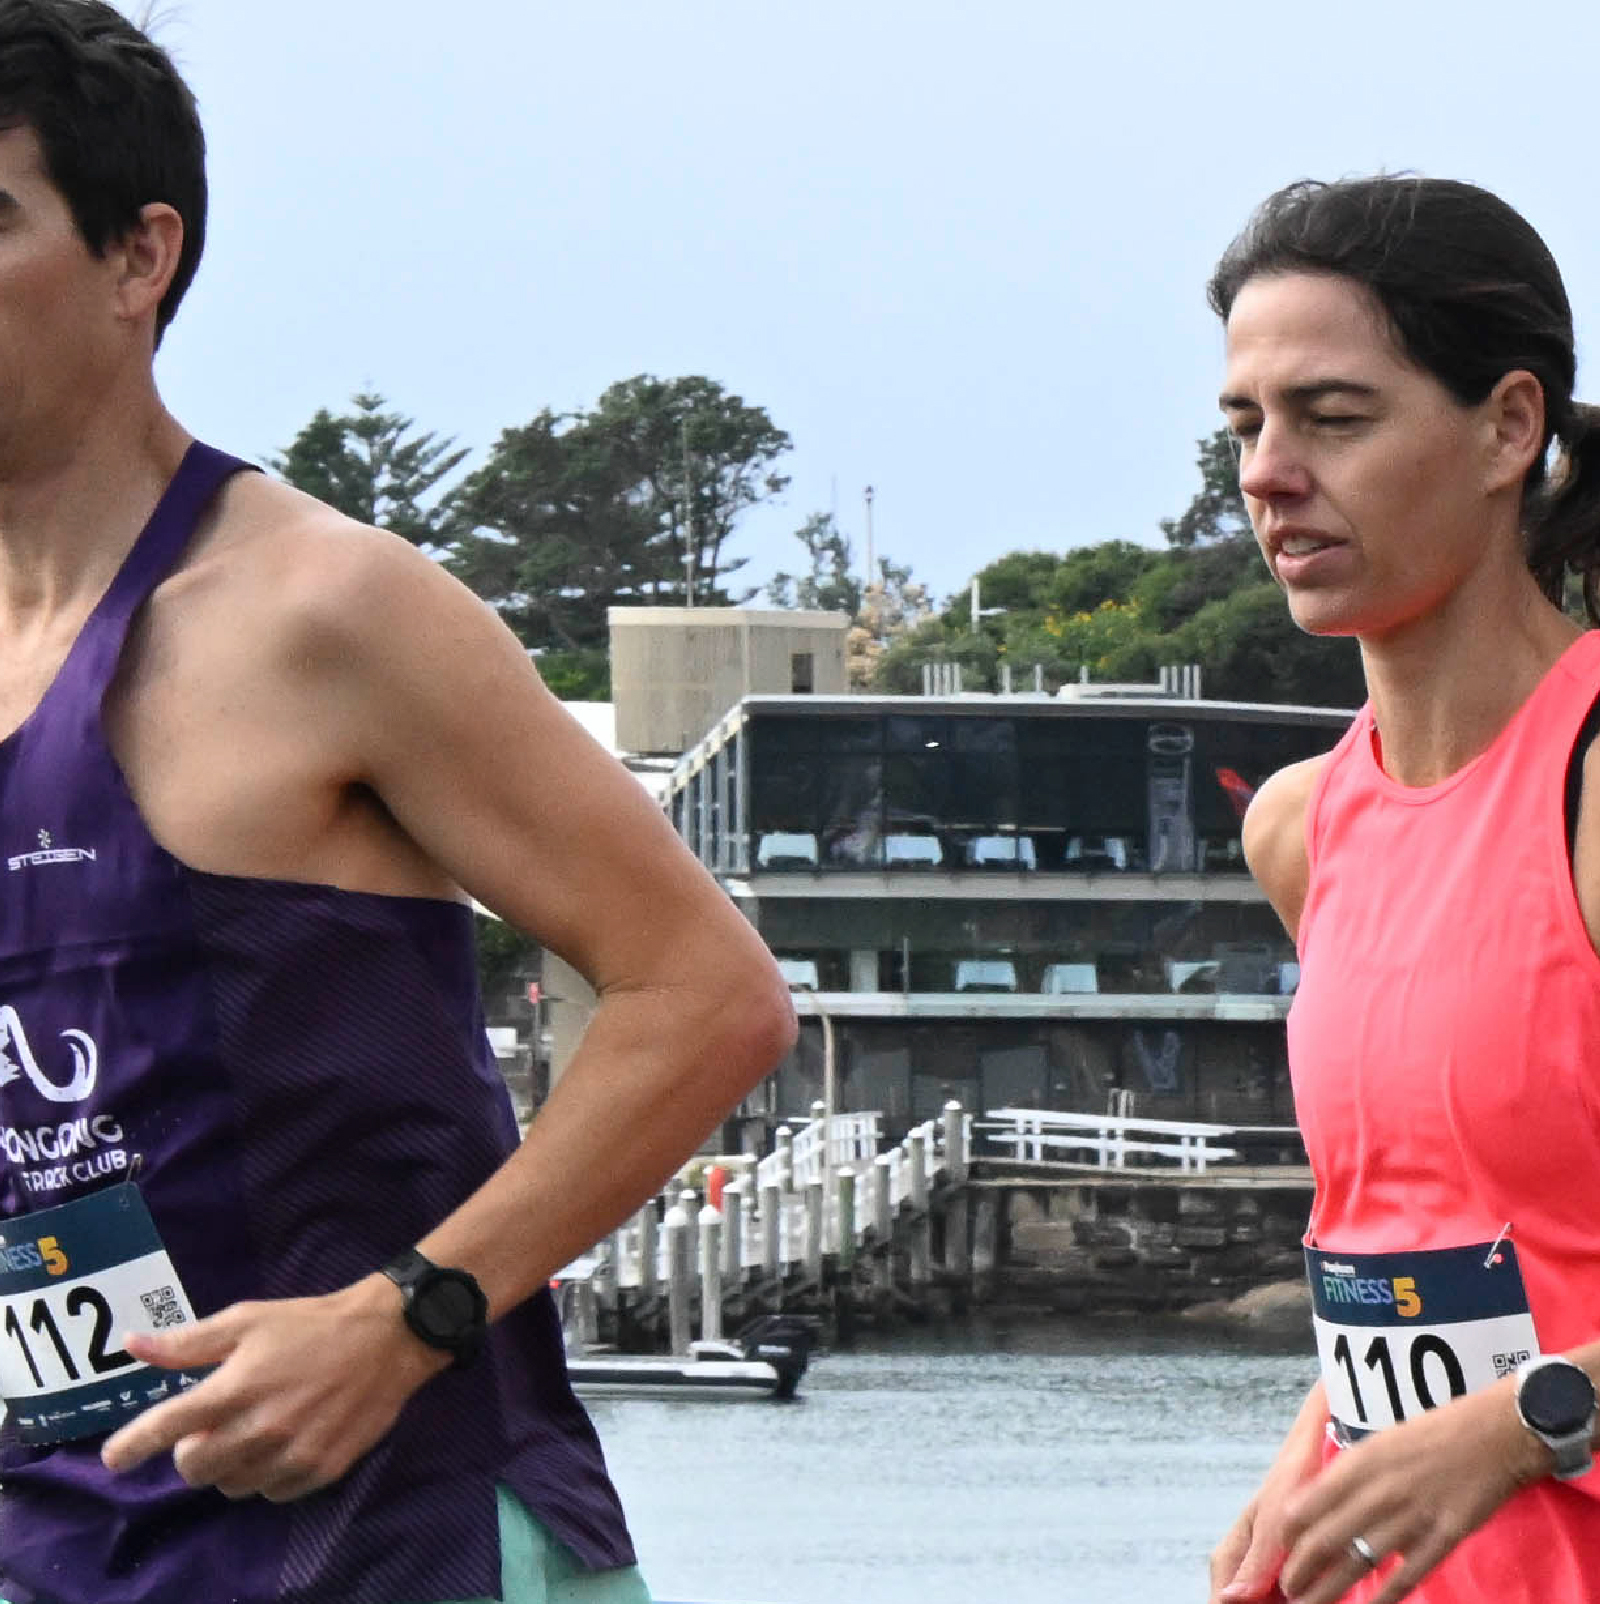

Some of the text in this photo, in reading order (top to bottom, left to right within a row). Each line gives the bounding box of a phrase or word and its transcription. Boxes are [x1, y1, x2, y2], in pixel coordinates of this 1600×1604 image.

[0, 1114, 123, 1163] ONGONG
[73, 1149, 127, 1182] CLUB
[38, 1237, 69, 1276] 5
[1322, 1276, 1422, 1317] FITNESS 5
[6, 1286, 136, 1388] 112
[1334, 1334, 1467, 1424] 110
